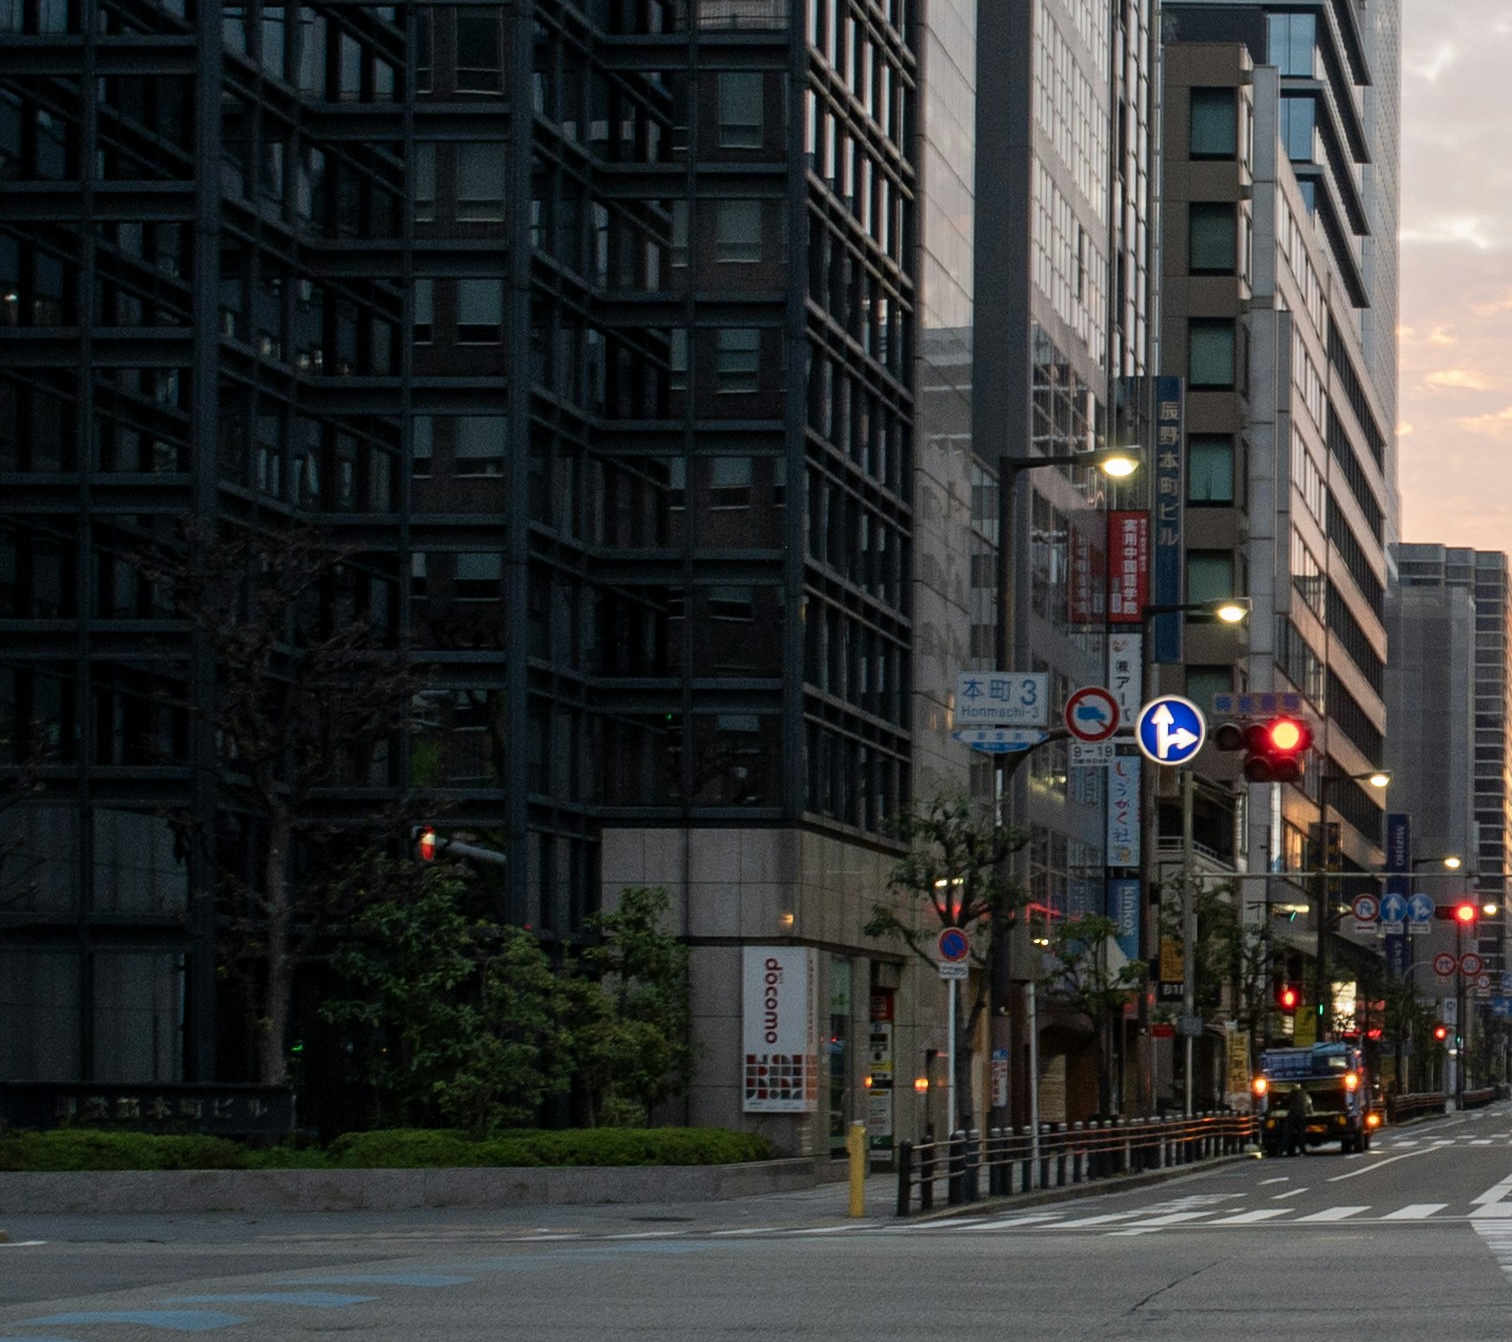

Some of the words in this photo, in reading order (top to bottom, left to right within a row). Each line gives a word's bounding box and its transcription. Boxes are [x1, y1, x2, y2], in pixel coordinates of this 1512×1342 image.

[1158, 400, 1181, 547] 辰野本町ビル
[961, 706, 1040, 720] Honmachi-3
[764, 958, 783, 1045] docomo
